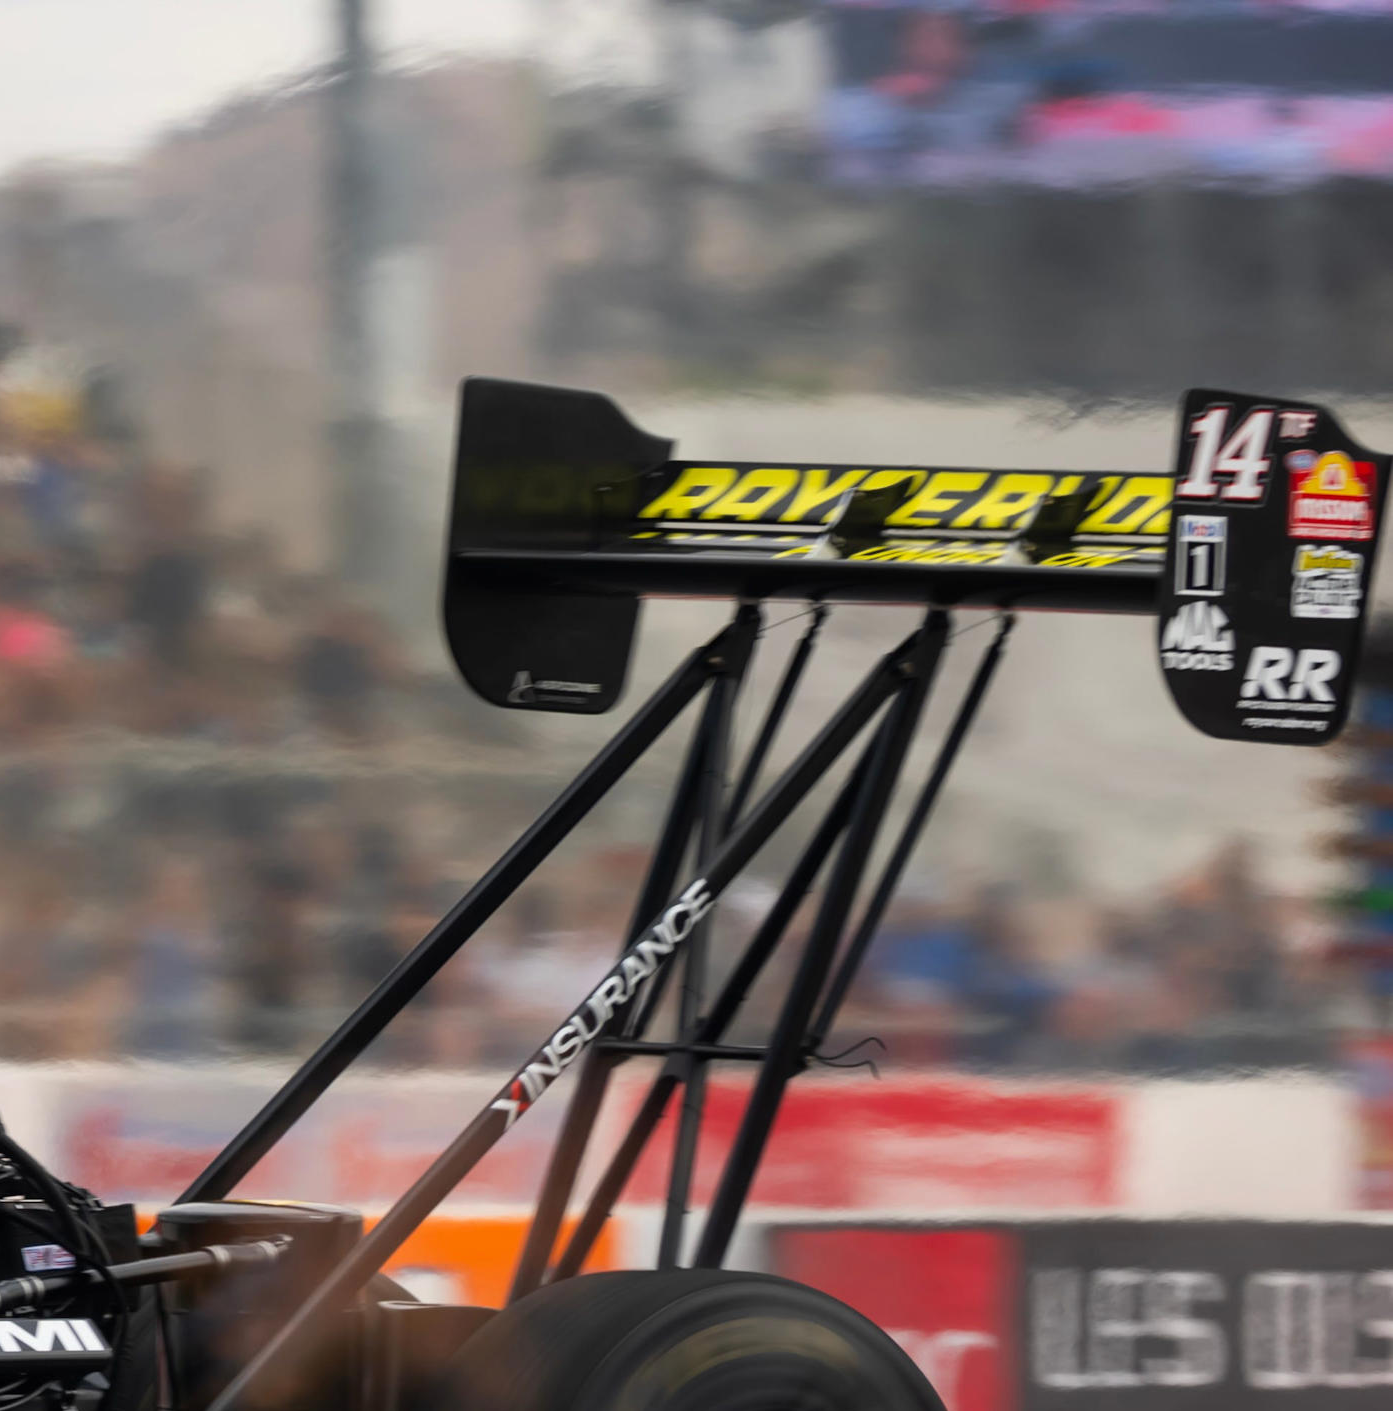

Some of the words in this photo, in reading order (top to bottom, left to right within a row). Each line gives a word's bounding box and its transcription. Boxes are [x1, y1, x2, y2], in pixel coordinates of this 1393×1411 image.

[1175, 405, 1275, 501] 14
[1162, 652, 1235, 671] TOOLS
[1240, 646, 1342, 701] RR
